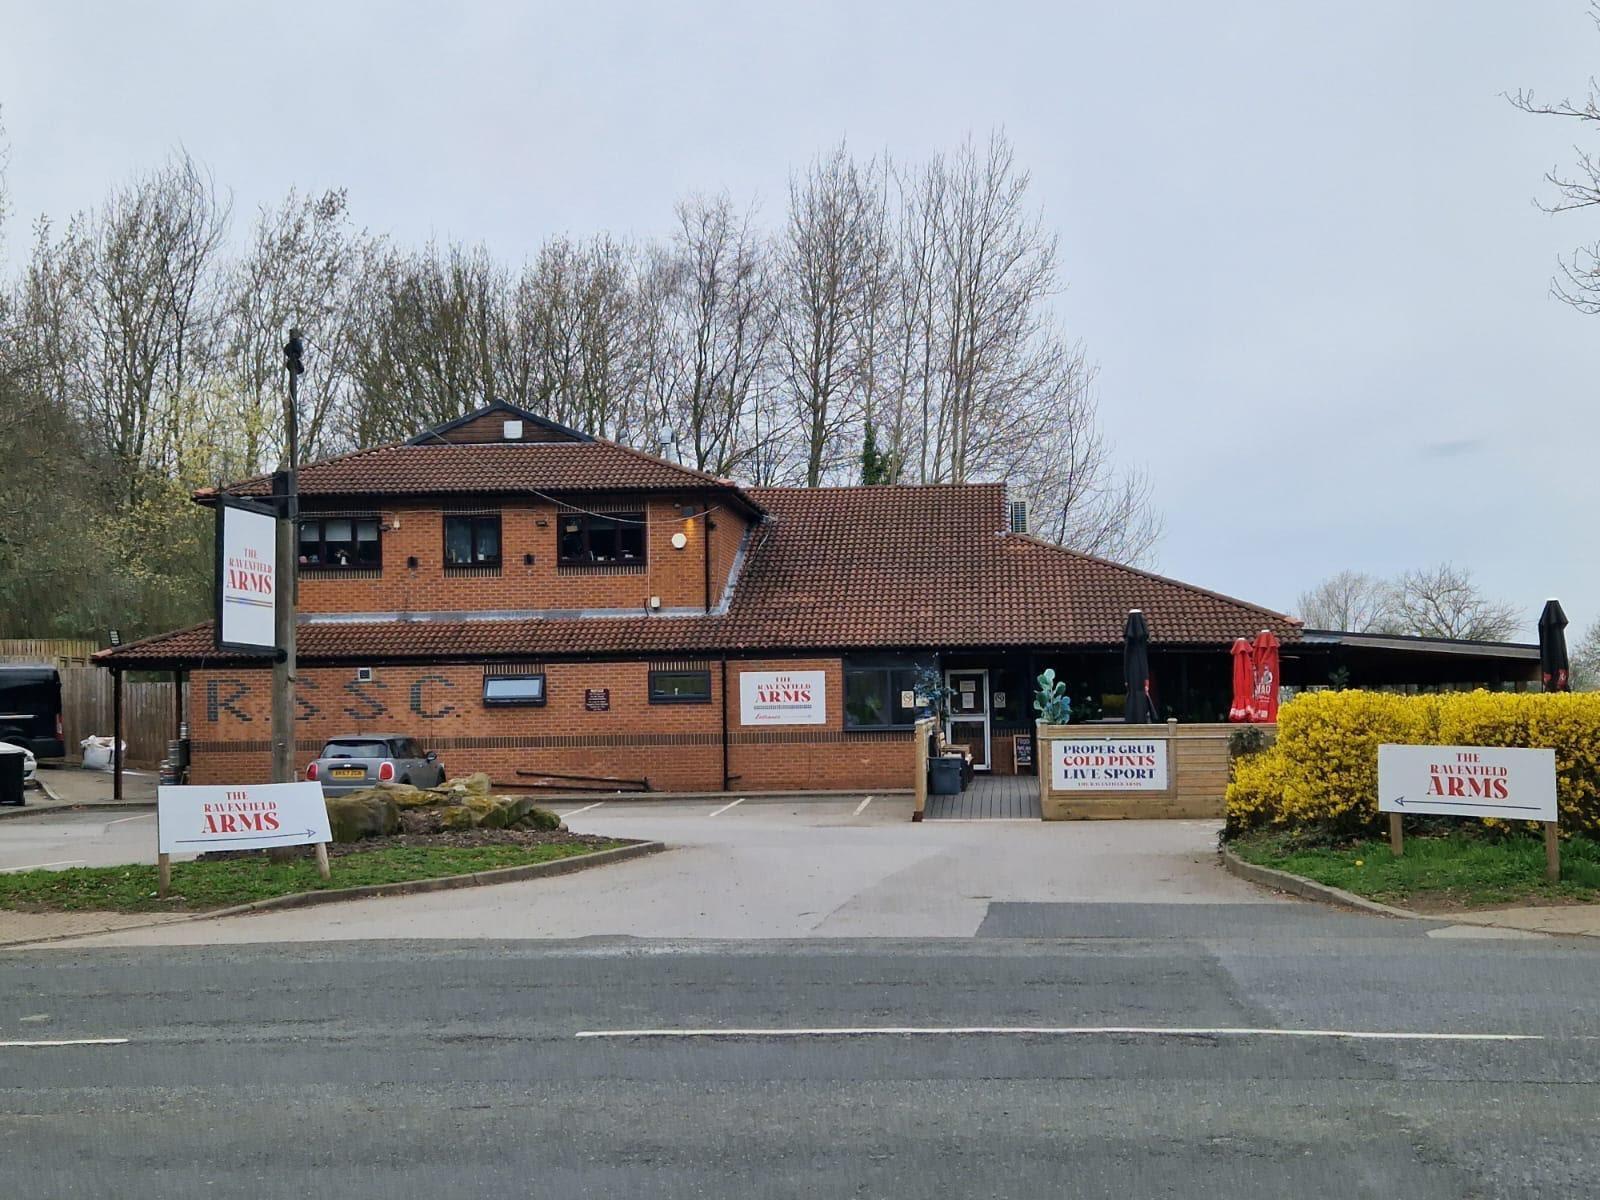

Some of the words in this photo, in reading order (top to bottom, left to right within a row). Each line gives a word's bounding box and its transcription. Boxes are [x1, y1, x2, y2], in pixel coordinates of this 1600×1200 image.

[244, 548, 257, 558] THE
[229, 557, 272, 572] RAVENFIELD
[227, 569, 272, 594] ARMS
[755, 690, 811, 703] ARMS
[1063, 745, 1116, 754] PROPER
[1119, 745, 1155, 754] GRUB
[1063, 756, 1105, 766] COLD
[1109, 756, 1155, 766] PINTS
[1456, 753, 1480, 763] THE
[1063, 769, 1100, 779] LIVE
[1104, 769, 1156, 779] SPORT
[1430, 764, 1508, 777] RAVENFIELD
[1426, 776, 1509, 799] ARMS
[226, 792, 248, 800] THE
[204, 801, 277, 813] RAVENFIELD
[202, 812, 280, 833] ARMS
